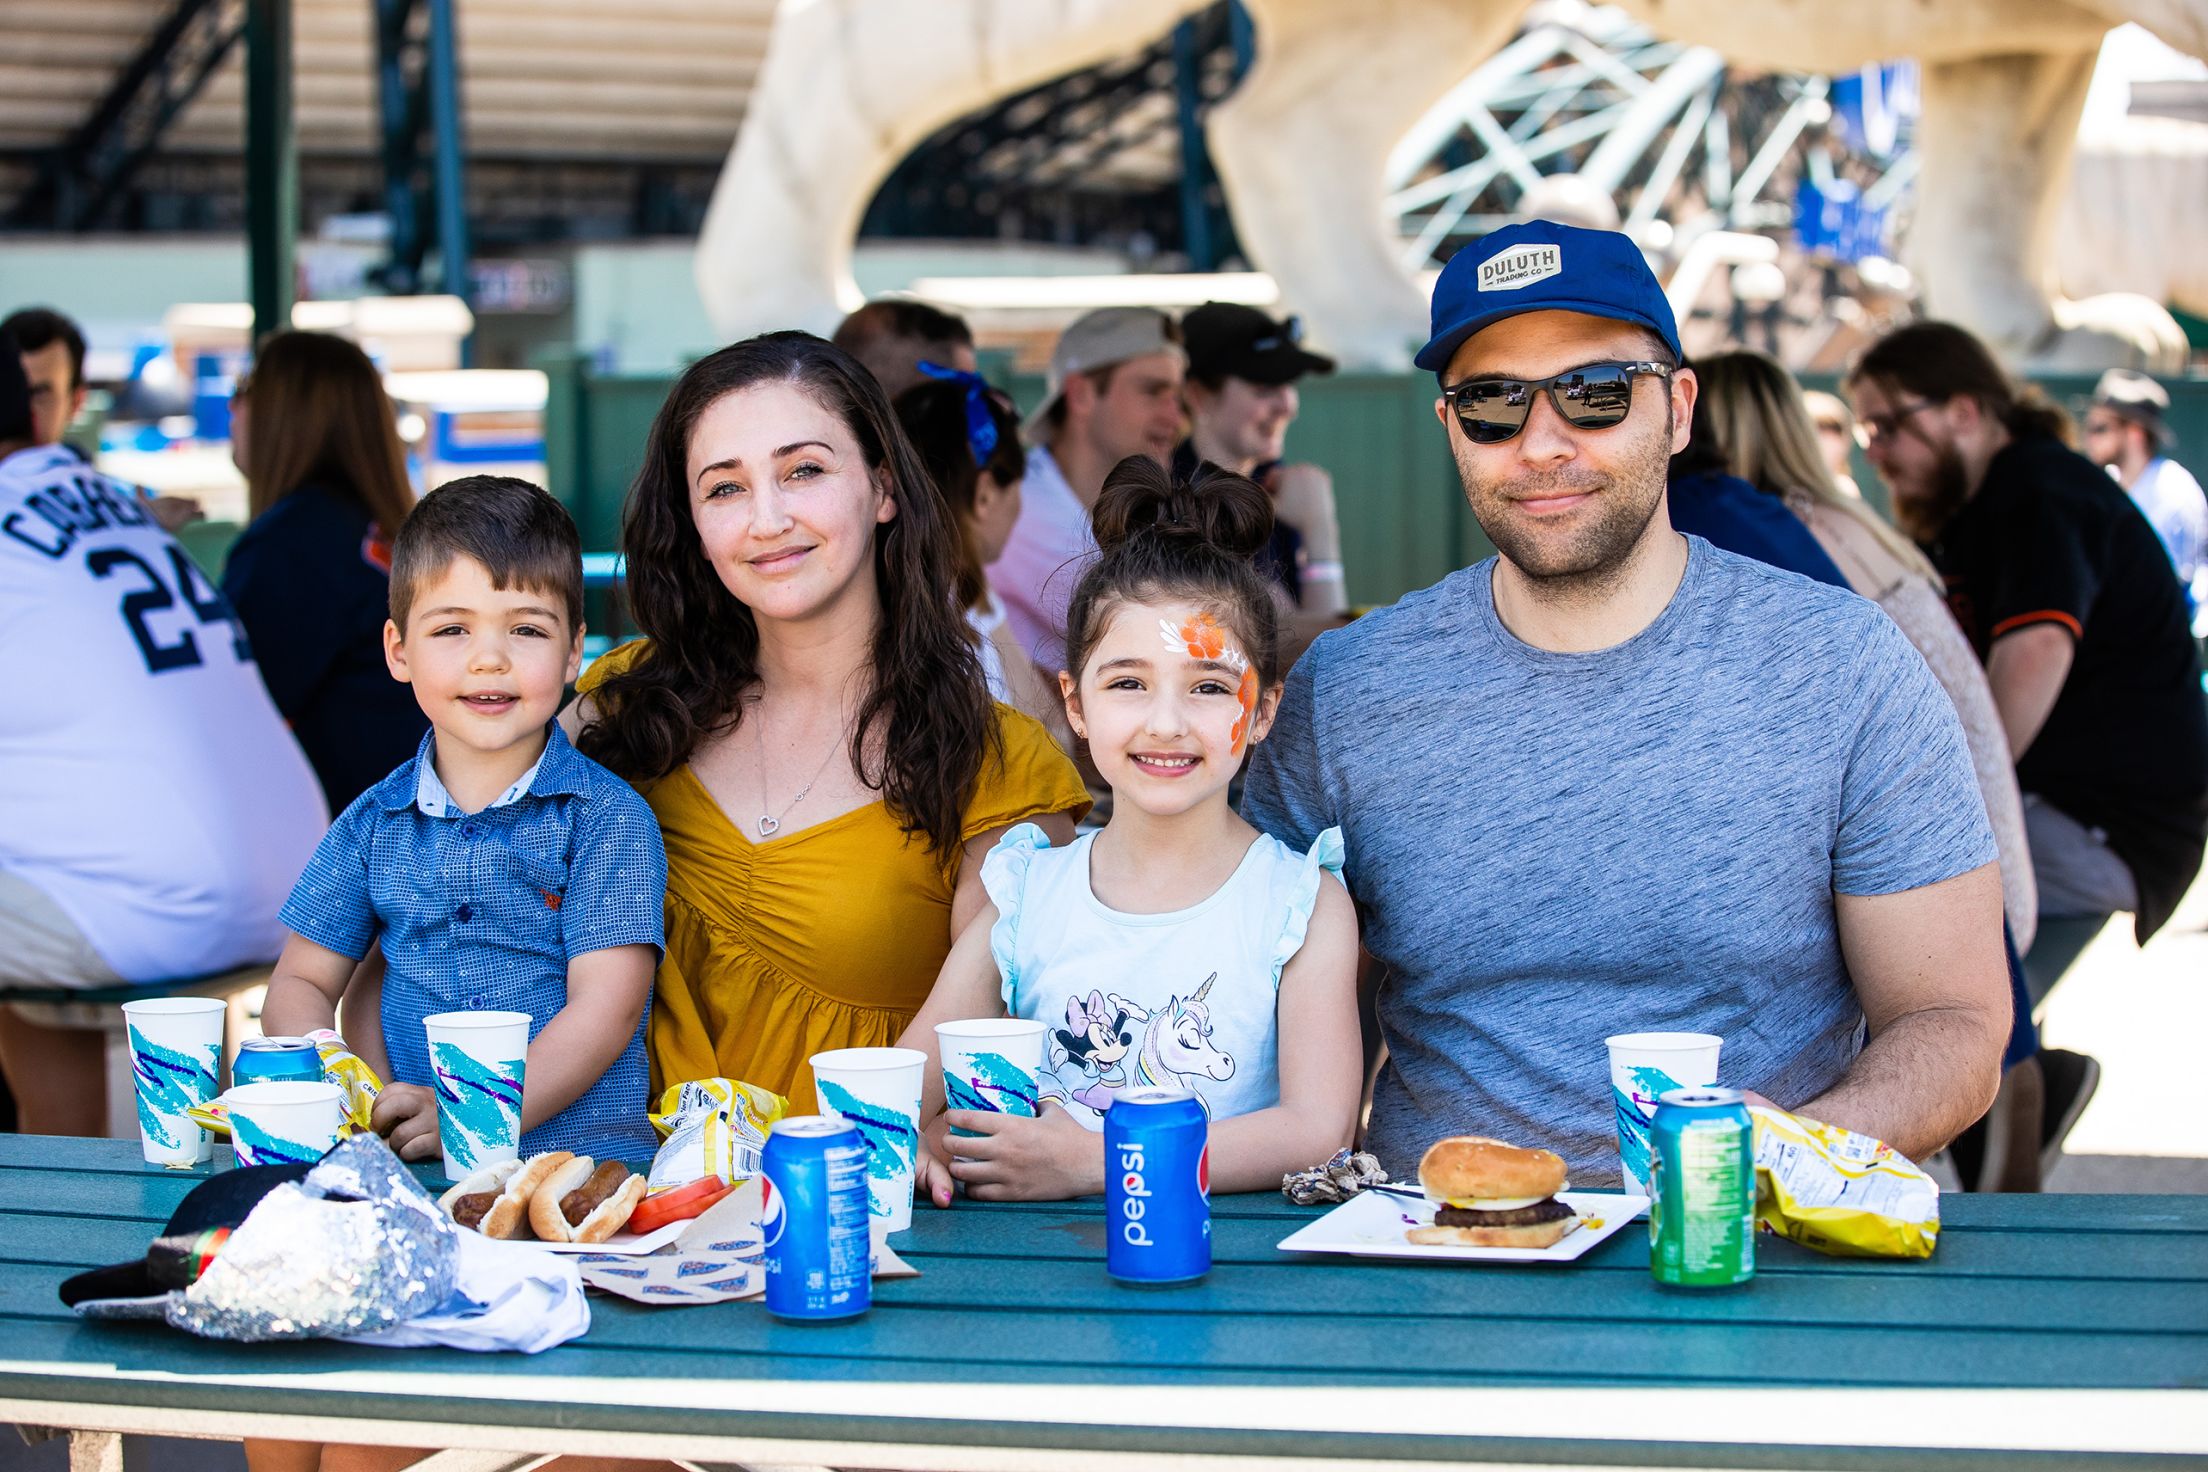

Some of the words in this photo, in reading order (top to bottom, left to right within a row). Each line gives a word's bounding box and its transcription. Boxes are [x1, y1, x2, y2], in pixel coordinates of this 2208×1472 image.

[1483, 250, 1555, 280] DULUTH
[1496, 271, 1529, 284] TRADING
[1531, 268, 1542, 276] CO
[85, 544, 255, 672] 24
[1117, 1143, 1154, 1247] pepsi
